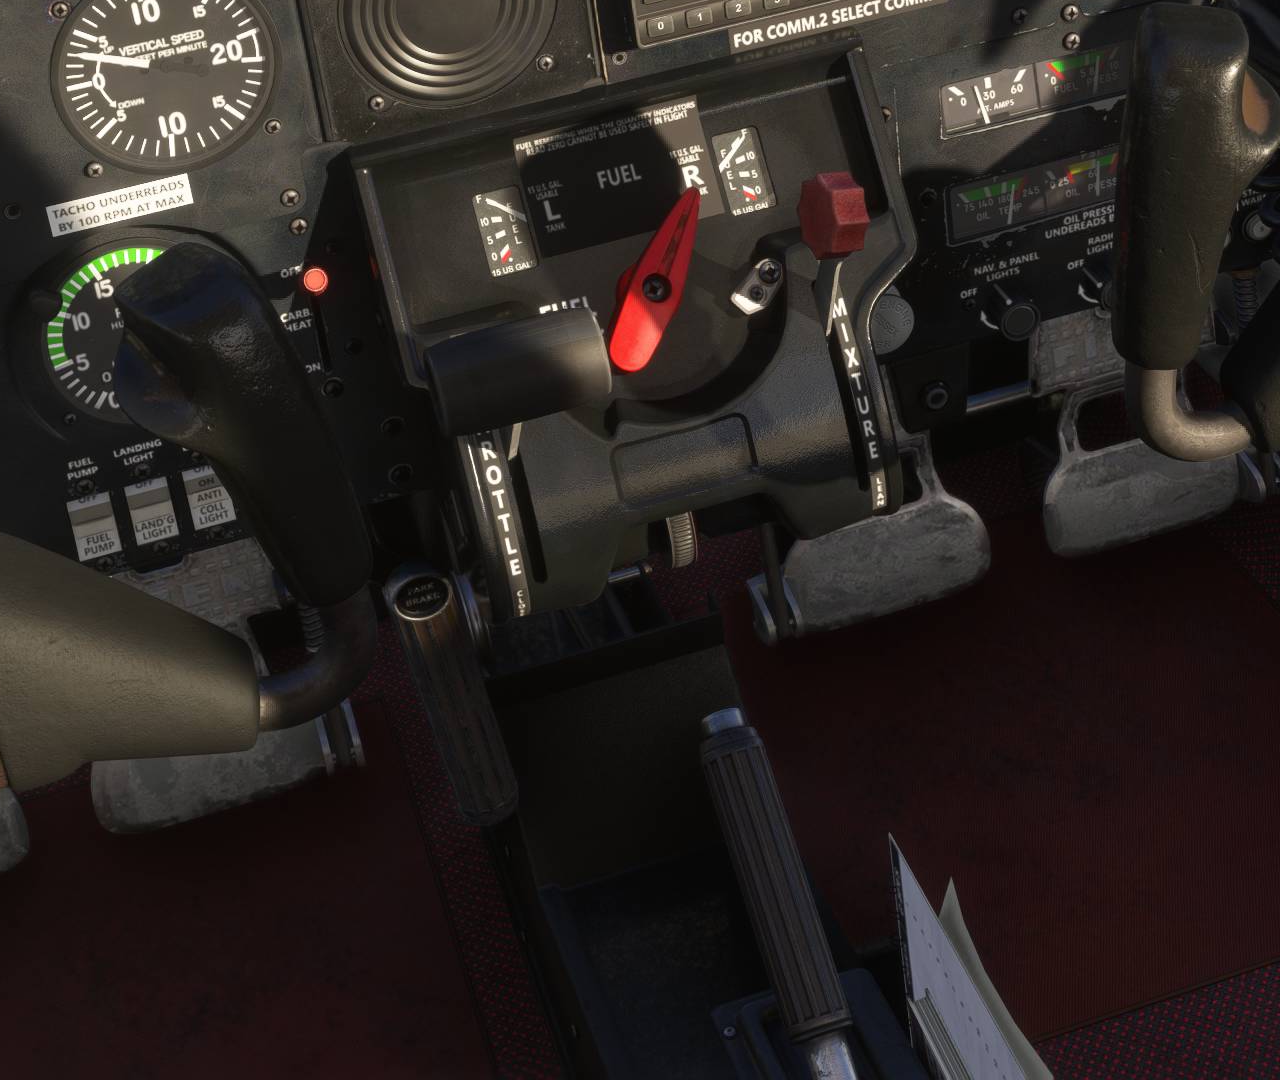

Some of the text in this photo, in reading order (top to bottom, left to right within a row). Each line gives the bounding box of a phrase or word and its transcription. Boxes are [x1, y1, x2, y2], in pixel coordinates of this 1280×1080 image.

[733, 30, 764, 49] FOR
[767, 15, 829, 40] COMM.2
[831, 2, 882, 25] SELECT
[119, 29, 204, 56] VERTICAL SPEED
[210, 40, 242, 66] 20
[597, 164, 642, 190] FUEL
[682, 165, 705, 188] R
[52, 180, 184, 220] TACHO UNDERREADS
[59, 193, 185, 232] BY 100 RPM AT MAX
[543, 199, 561, 221] L
[545, 223, 567, 233] TANK
[999, 259, 1007, 269] &
[1010, 252, 1040, 266] PANEL
[1067, 259, 1085, 270] OFF
[986, 268, 1020, 282] LIGHTS
[960, 288, 978, 299] OFF
[286, 319, 312, 332] HEAT
[832, 297, 879, 459] MIXTURE
[113, 439, 162, 458] LANDING
[68, 457, 95, 470] FUEL
[123, 451, 155, 466] LIGHT
[67, 466, 98, 480] PUMP
[198, 478, 215, 487] ON
[198, 490, 222, 502] ANTI
[200, 503, 225, 515] COLL
[479, 441, 522, 577] ROTTLE
[200, 511, 230, 525] LIGHT
[86, 534, 111, 545] FUEL
[143, 525, 173, 540] LIGHT
[84, 541, 115, 556] PUMP
